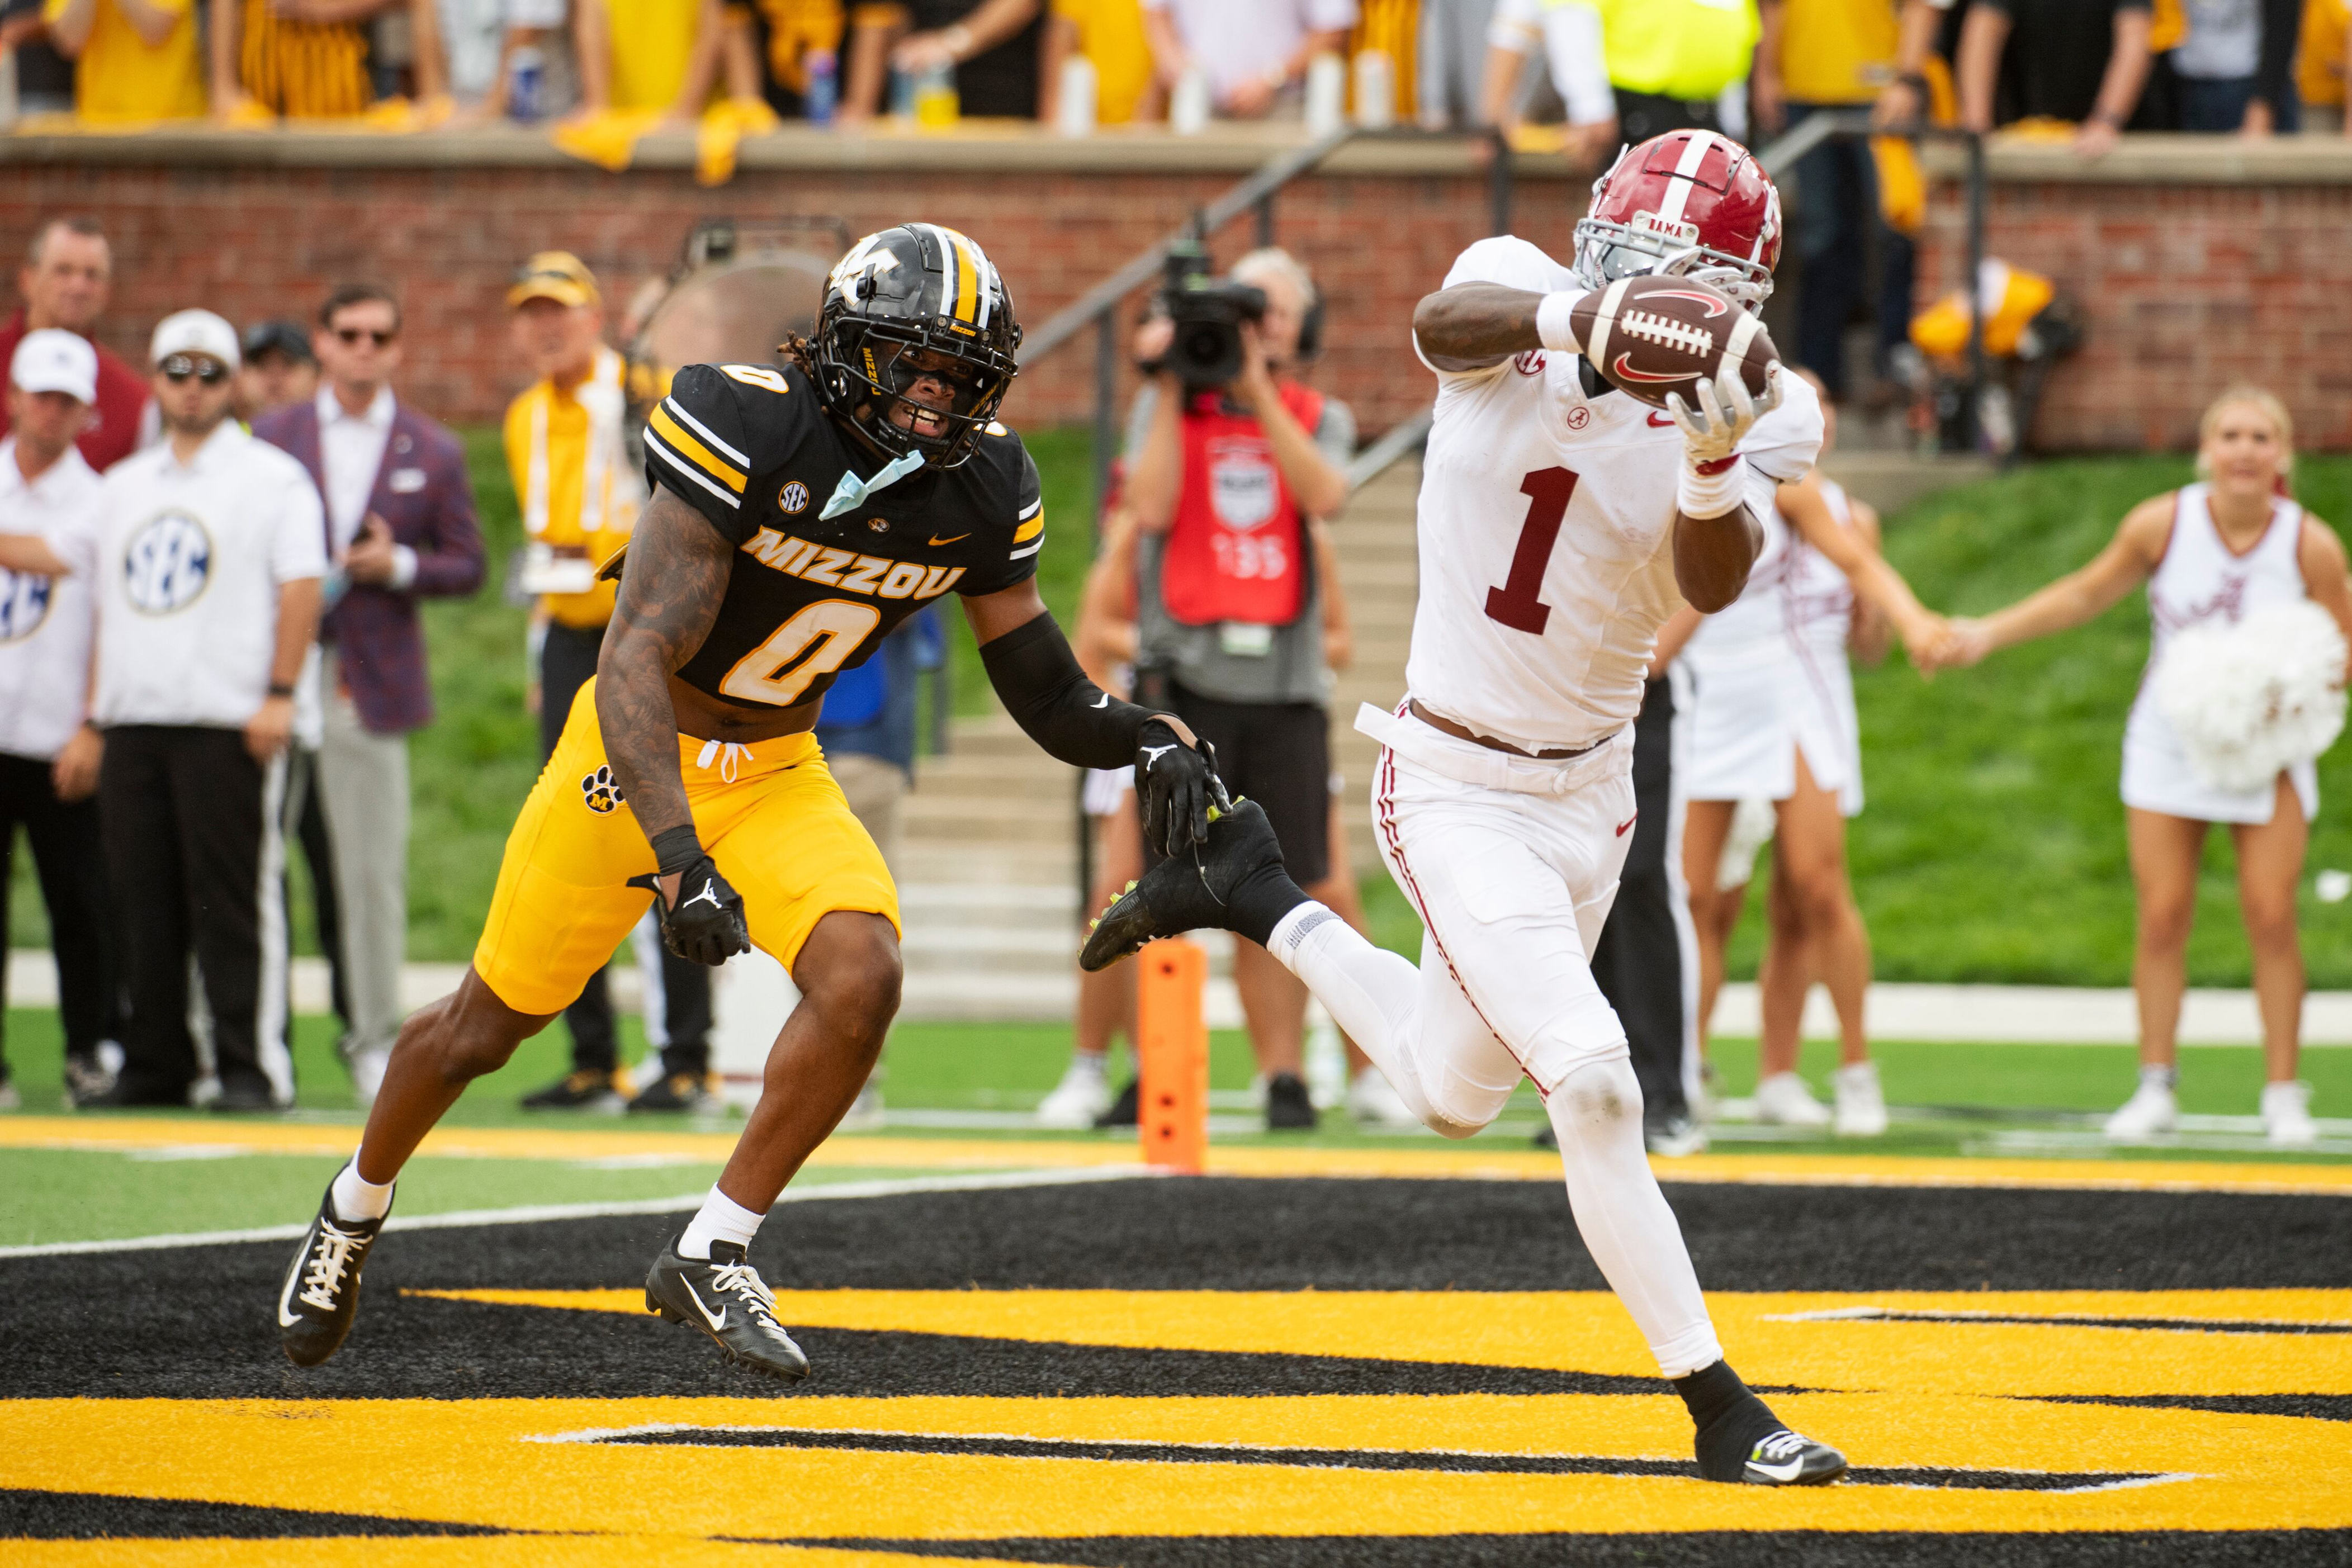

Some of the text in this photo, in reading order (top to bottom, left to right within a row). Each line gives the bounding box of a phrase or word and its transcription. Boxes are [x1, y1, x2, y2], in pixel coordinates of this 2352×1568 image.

[949, 324, 976, 337] MIZZOU
[781, 483, 807, 511] SEC
[740, 524, 967, 600] MIZZOU
[1484, 466, 1579, 636] 1
[719, 599, 881, 707] 0
[589, 793, 611, 811] M
